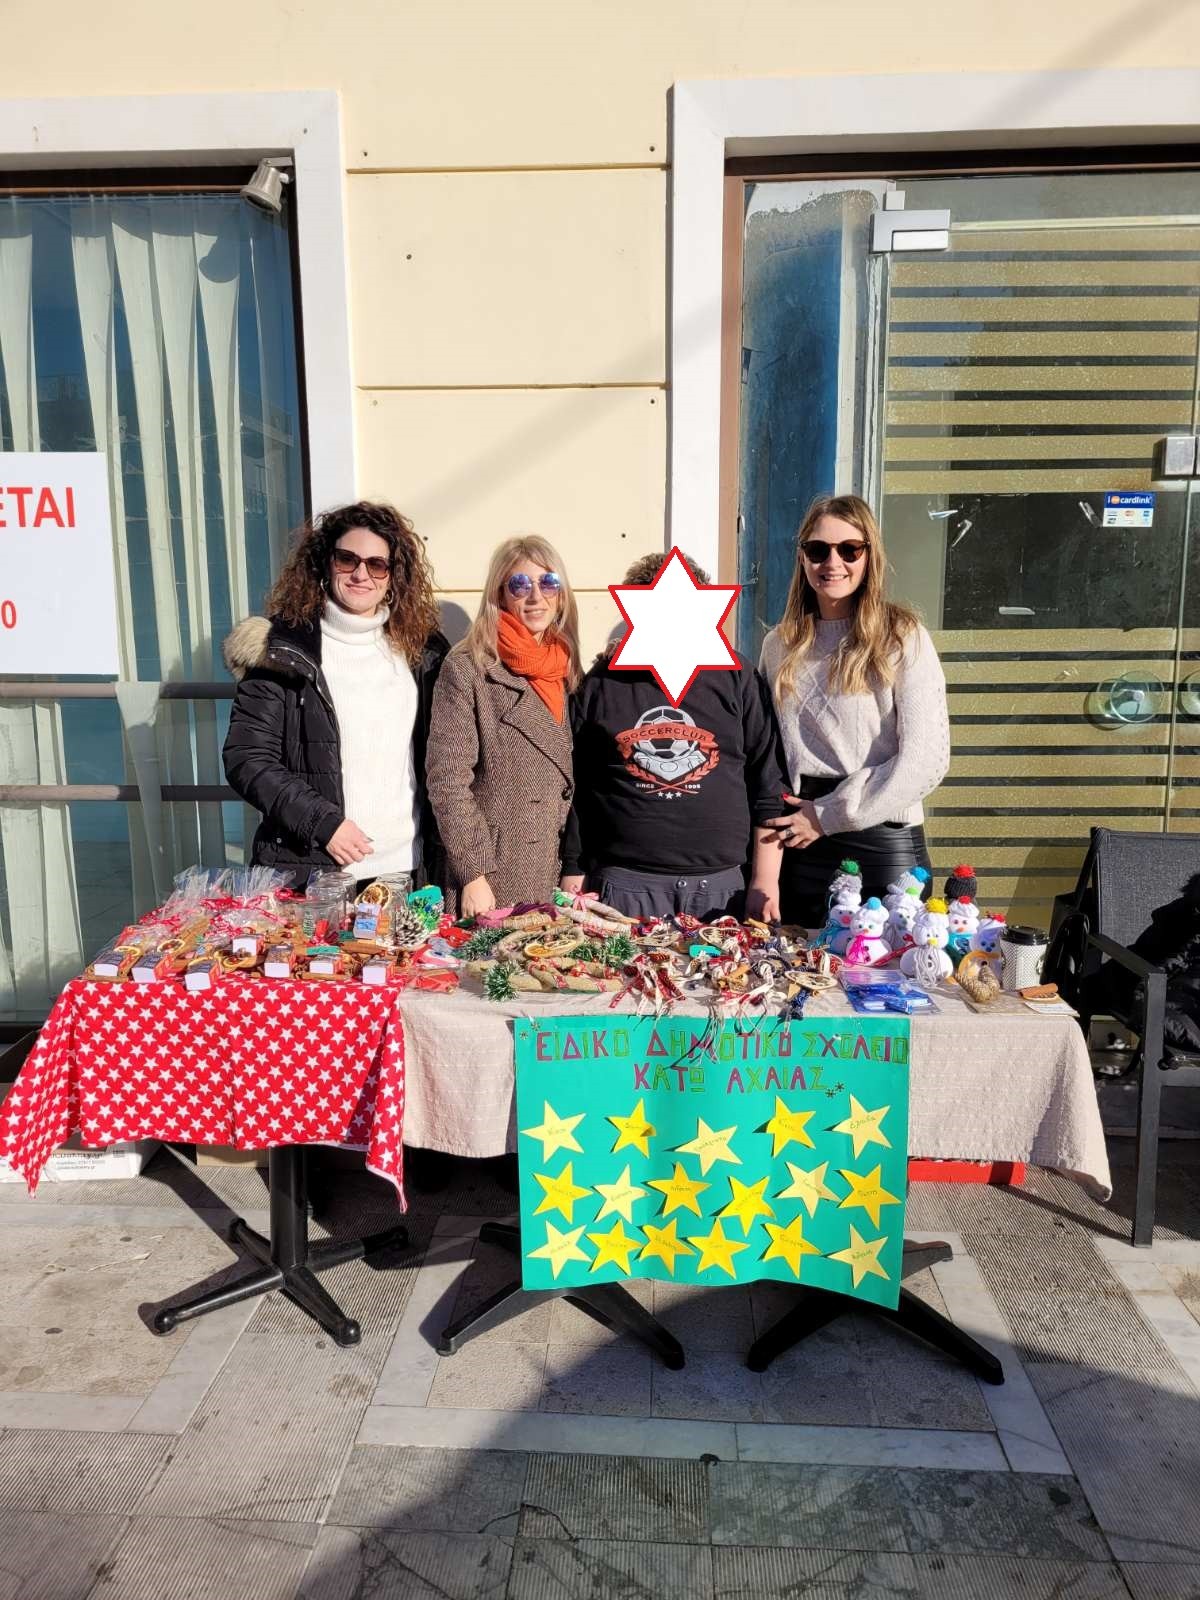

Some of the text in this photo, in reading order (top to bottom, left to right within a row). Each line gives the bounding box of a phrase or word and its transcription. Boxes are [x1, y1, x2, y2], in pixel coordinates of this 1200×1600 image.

[1120, 495, 1151, 504] cardlink
[536, 1028, 908, 1065] ΕΙΔΙΚΟ ΔΗΜΟΤΙΚΟ ΣΧΟΛΕΙΟ
[726, 1065, 828, 1095] ΑΧΑΙΑΣ
